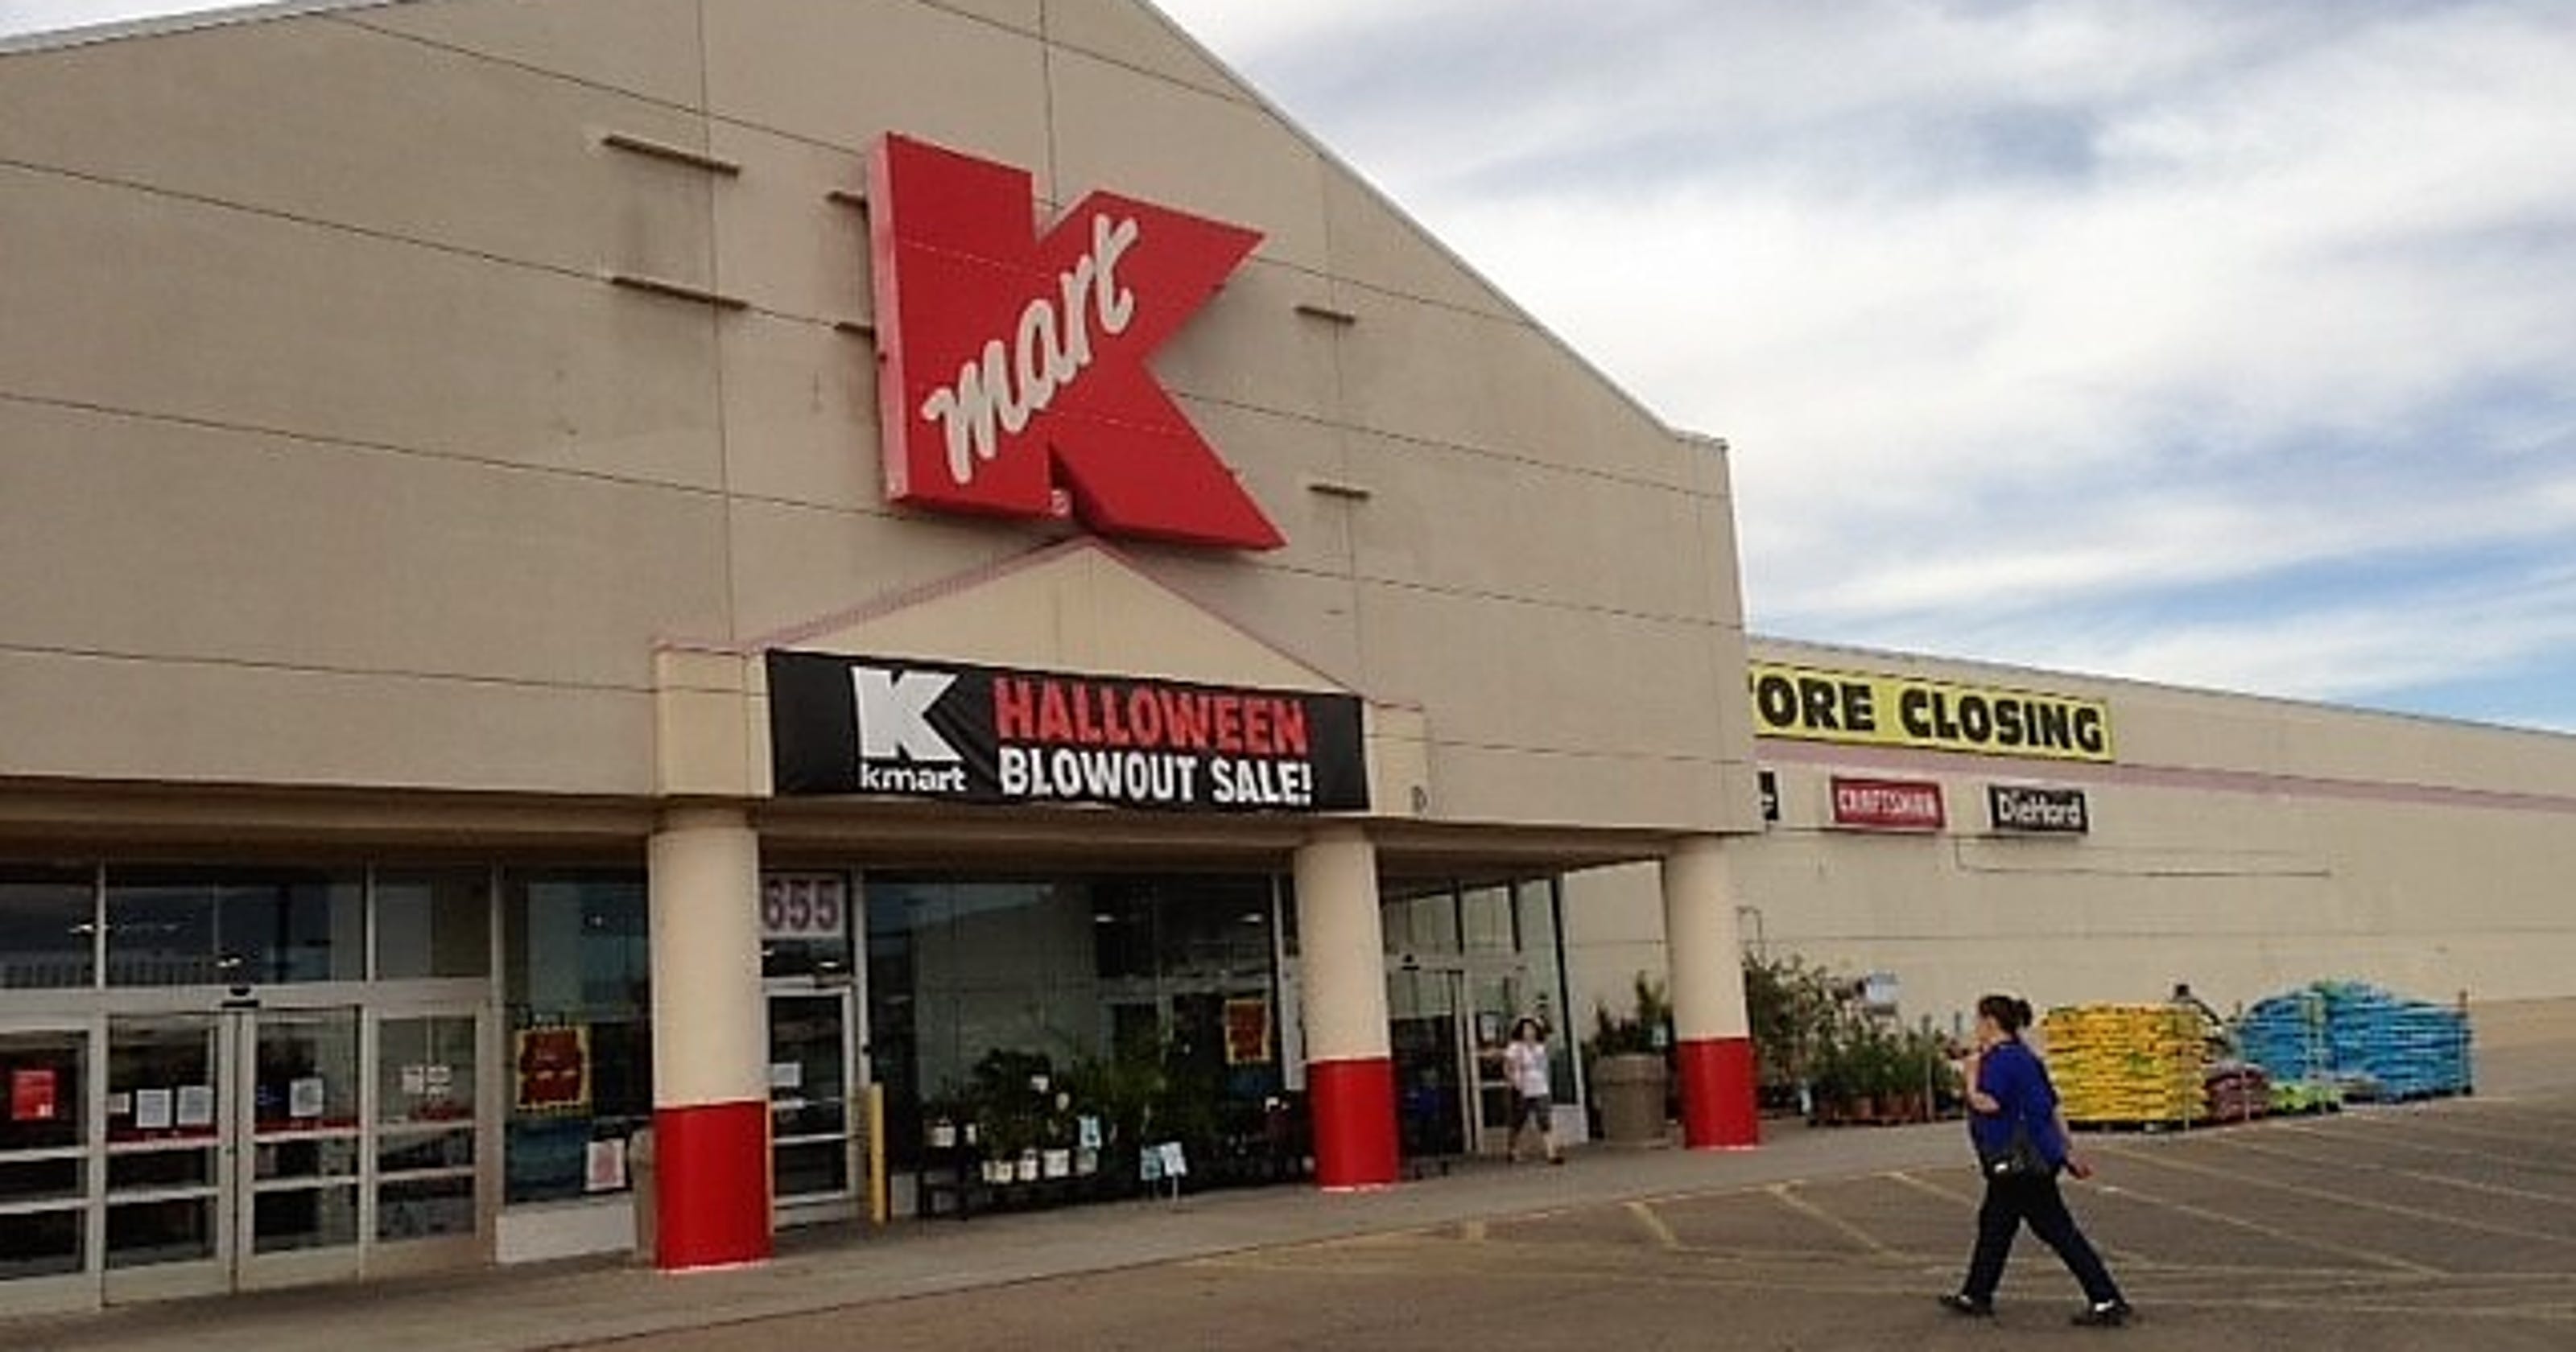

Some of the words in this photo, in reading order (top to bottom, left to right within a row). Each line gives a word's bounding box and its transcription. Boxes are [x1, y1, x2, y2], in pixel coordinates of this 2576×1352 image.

[868, 132, 1286, 550] K
[922, 213, 1139, 483] mart
[852, 666, 963, 761] K
[993, 677, 1307, 752] HALLOWEEN
[1748, 673, 1876, 731] ORE
[1900, 688, 2103, 752] CLOSING
[860, 762, 967, 792] kmart
[999, 747, 1197, 802] BLOWOUT
[1212, 759, 1312, 805] SALE!
[1998, 789, 2082, 828] DieHard
[762, 879, 839, 932] 655
